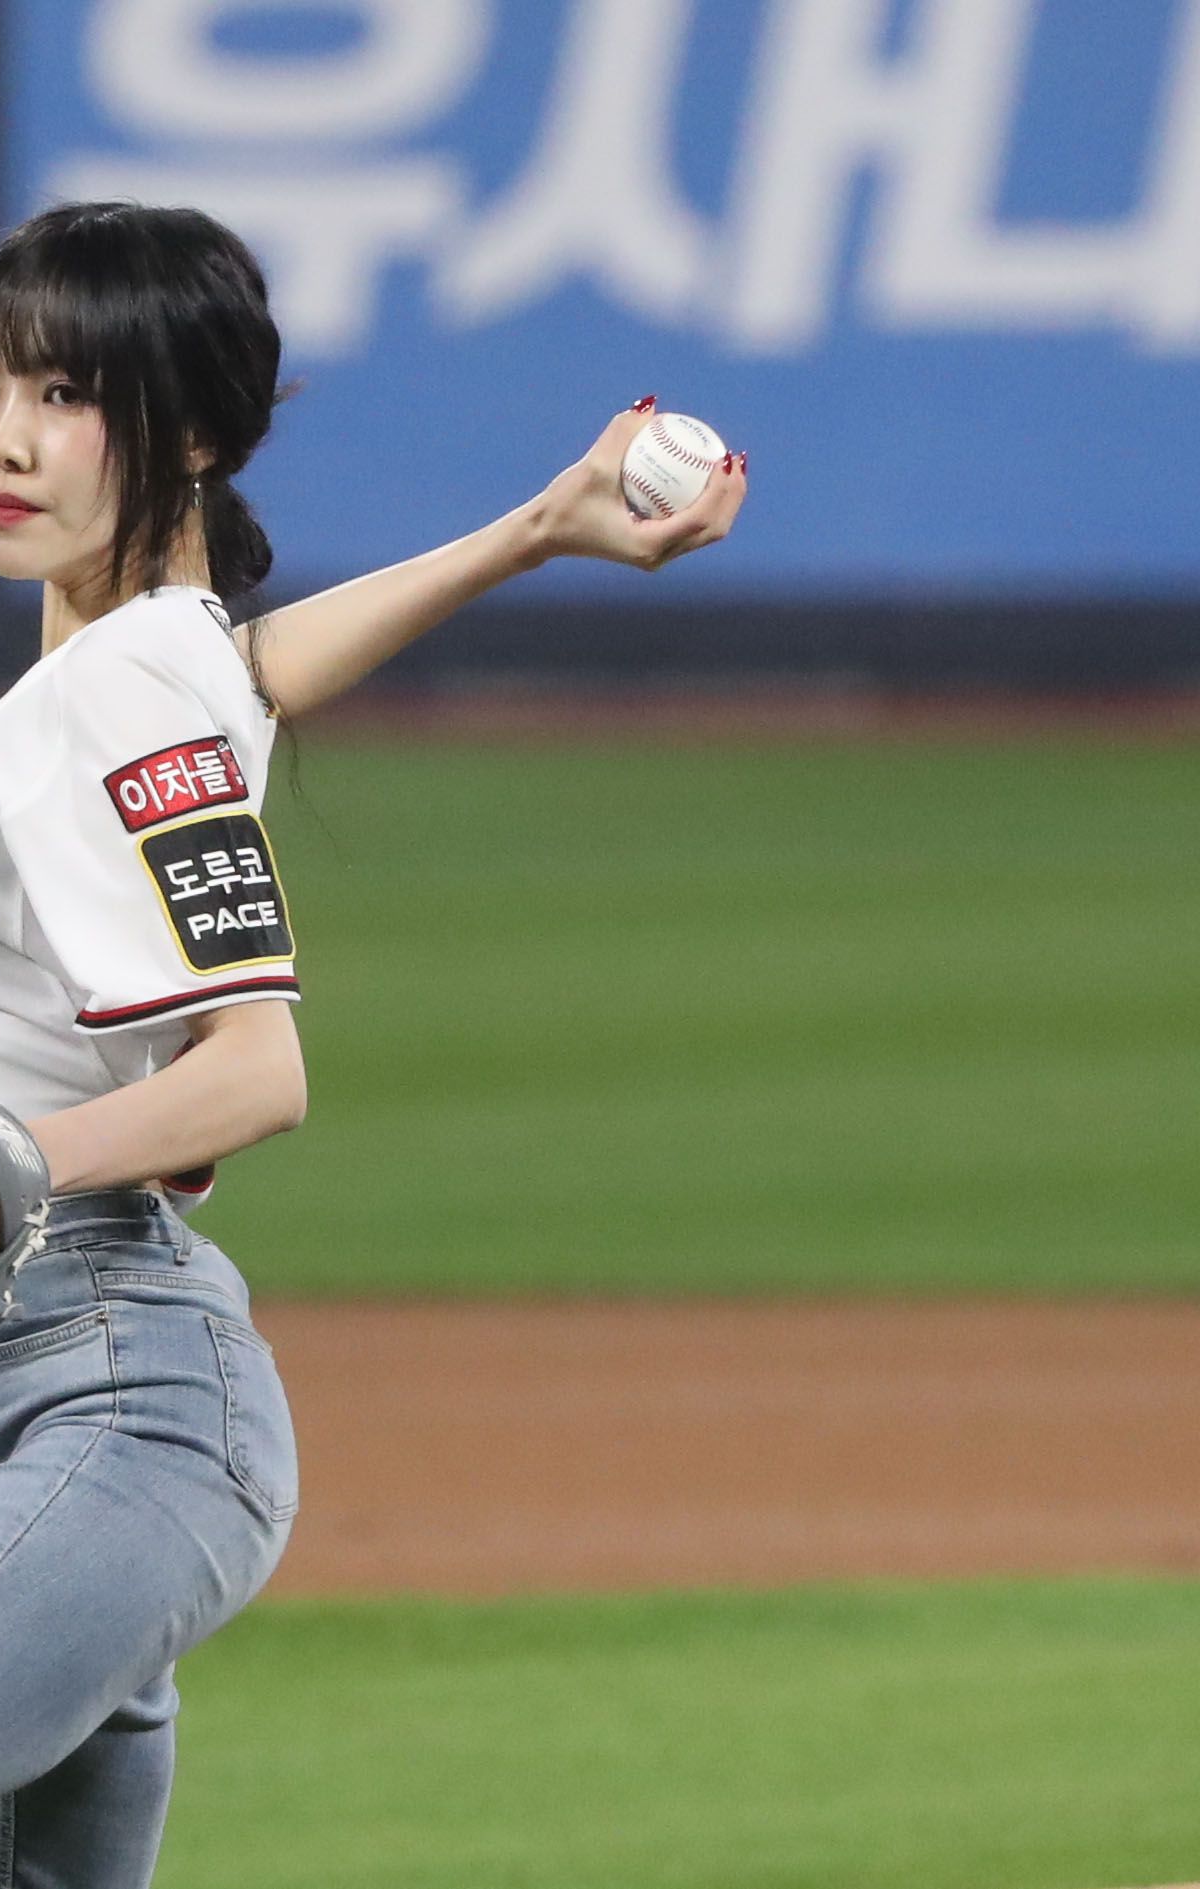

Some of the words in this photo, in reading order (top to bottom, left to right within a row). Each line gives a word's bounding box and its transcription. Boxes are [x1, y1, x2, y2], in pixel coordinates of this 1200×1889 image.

[119, 750, 231, 812] 이차돌
[163, 847, 272, 901] 도루코
[187, 900, 279, 941] PACE
